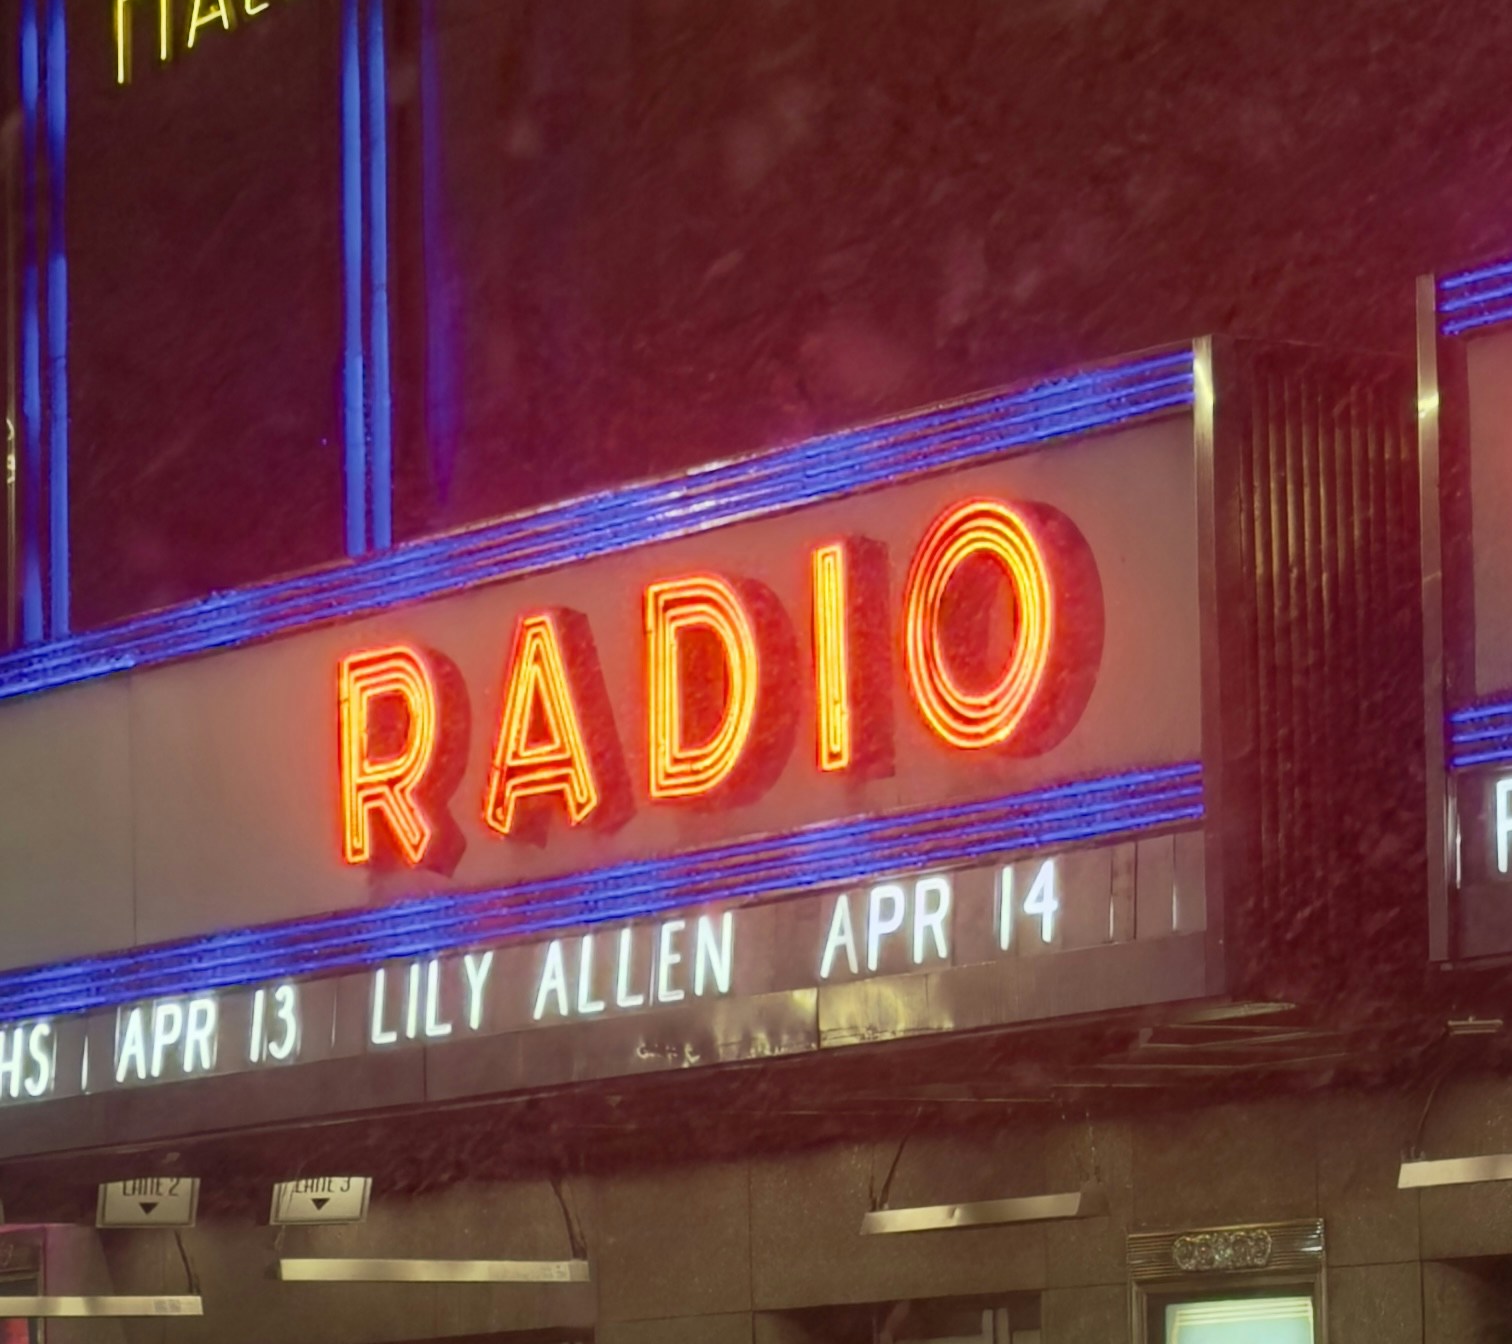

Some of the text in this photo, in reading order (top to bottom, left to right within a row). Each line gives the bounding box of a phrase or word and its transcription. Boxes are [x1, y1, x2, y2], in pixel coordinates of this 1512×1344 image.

[336, 496, 1056, 866] RADIO
[115, 998, 218, 1084] APR
[249, 984, 298, 1063] 13
[370, 950, 495, 1047] LILY
[533, 912, 735, 1021] ALLEN
[819, 875, 951, 980] APR
[999, 858, 1059, 951] 14
